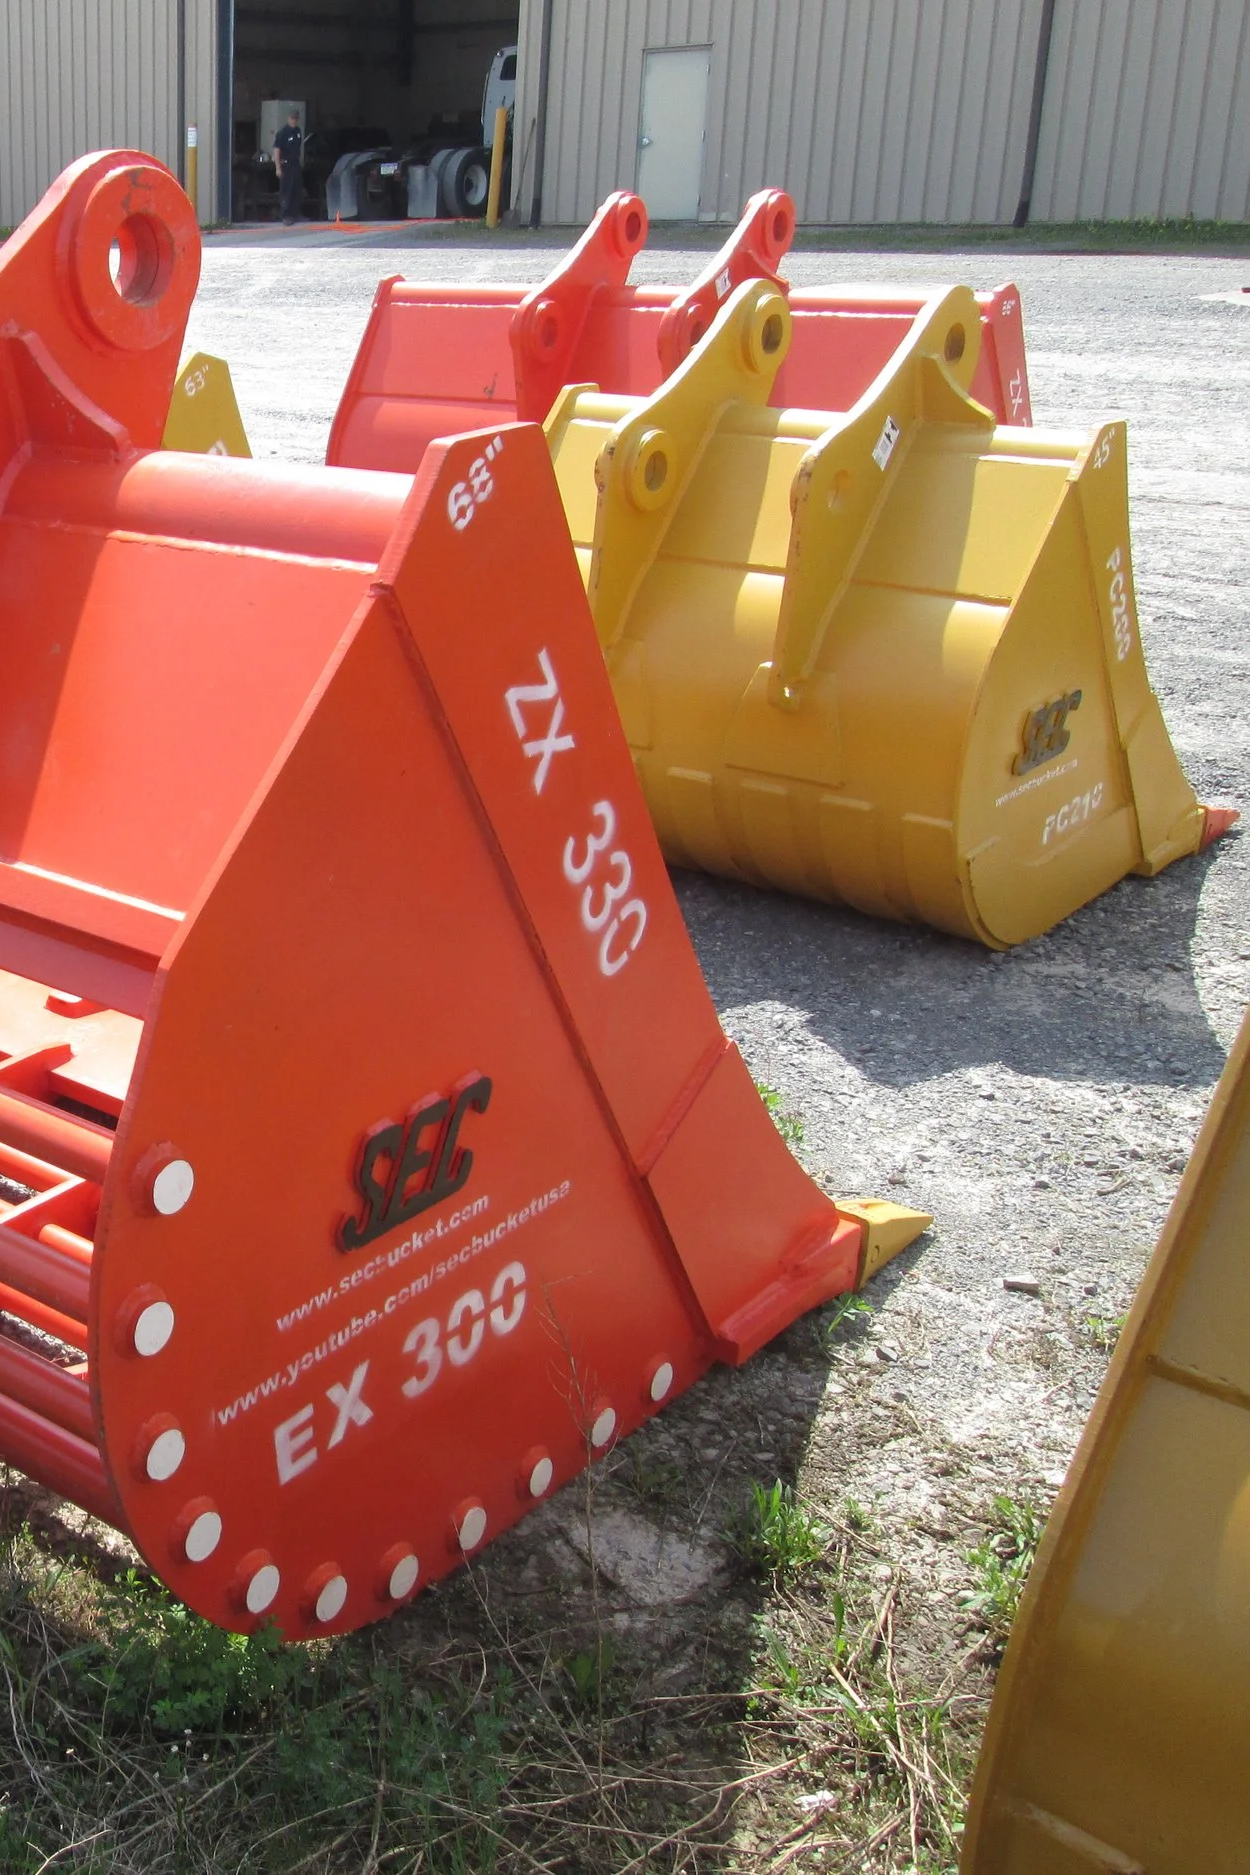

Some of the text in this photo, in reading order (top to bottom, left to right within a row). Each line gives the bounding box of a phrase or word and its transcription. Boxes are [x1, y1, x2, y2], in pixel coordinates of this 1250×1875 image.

[184, 364, 209, 397] 63"
[447, 434, 503, 531] 68"
[505, 647, 648, 978] ZX 330
[1011, 689, 1082, 776] SEC
[337, 1070, 492, 1254] SEC
[216, 1179, 574, 1426] www.youtube.com/secbucketusa
[273, 1260, 528, 1486] EX 300
